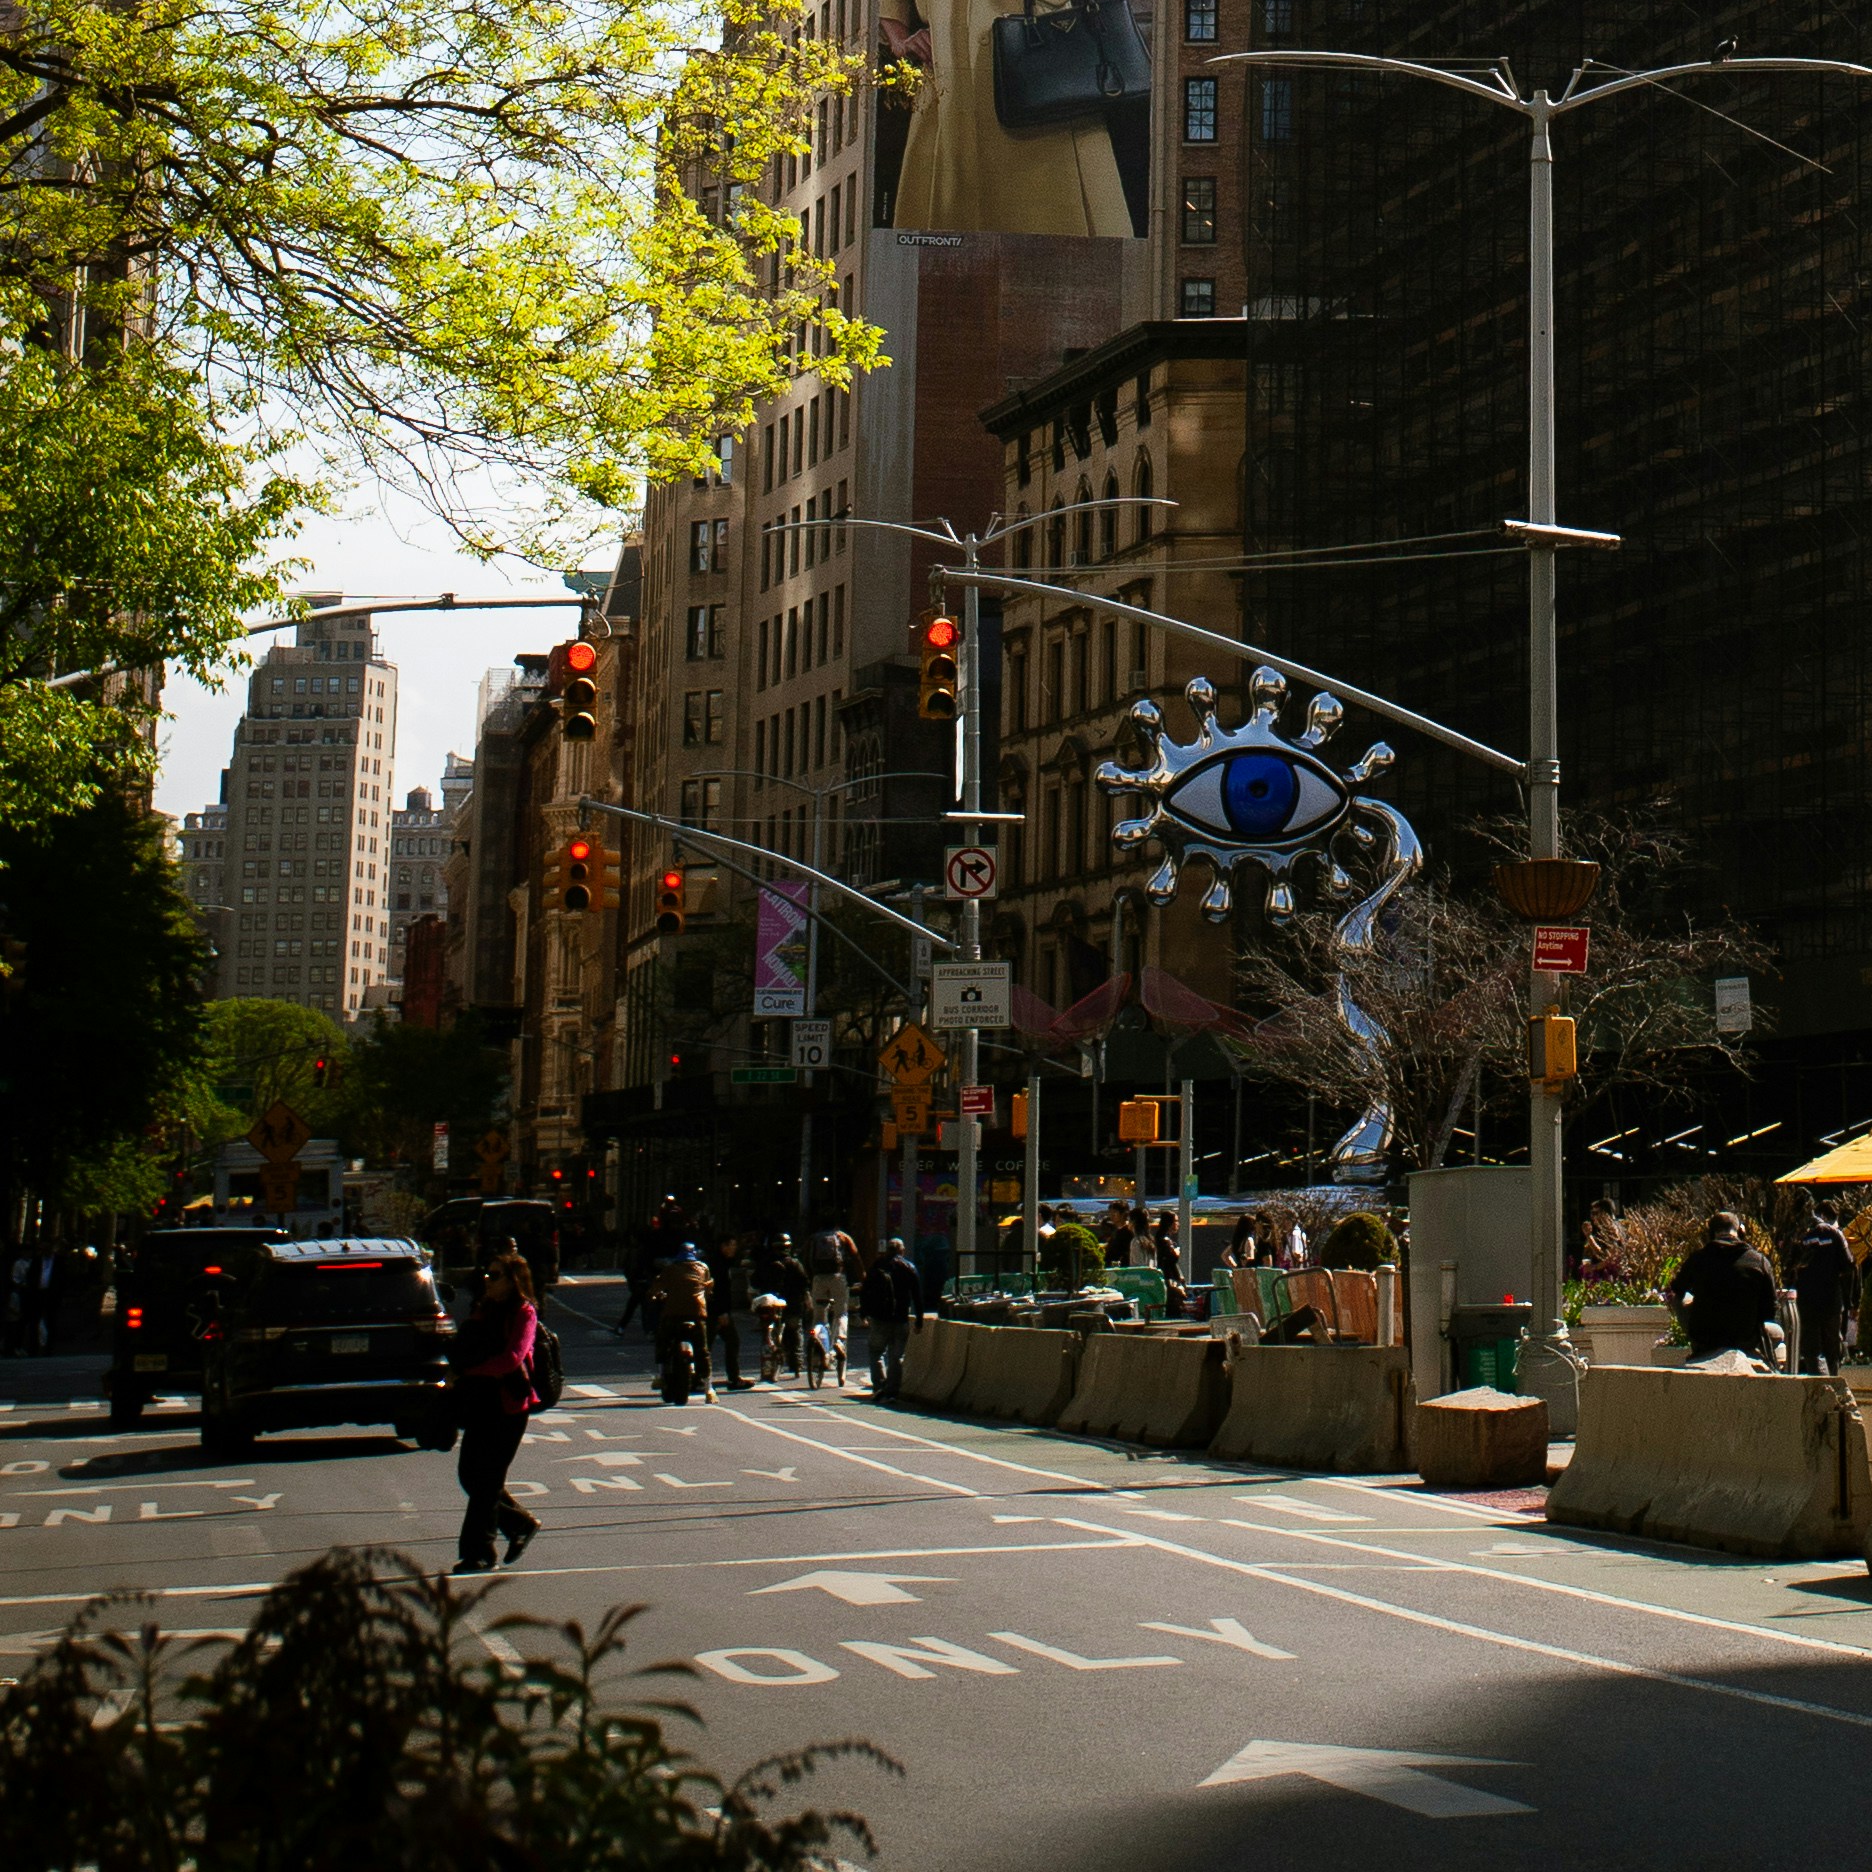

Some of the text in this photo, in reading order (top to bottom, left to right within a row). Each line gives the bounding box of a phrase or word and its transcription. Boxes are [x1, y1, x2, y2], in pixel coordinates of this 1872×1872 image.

[1537, 931, 1580, 941] NO STOPPING
[1537, 941, 1564, 951] Anytime
[983, 967, 1005, 975] STREET
[761, 996, 795, 1009] Cure
[943, 1005, 999, 1014] BUS CORRIDOR
[938, 1015, 1005, 1024] PHOTO ENFORCED
[795, 1023, 828, 1032] SPEED
[797, 1034, 824, 1042] LIMIT
[799, 1046, 822, 1064] 10
[906, 1106, 918, 1121] 5
[275, 1186, 287, 1200] 5
[694, 1617, 1300, 1686] ONLY
